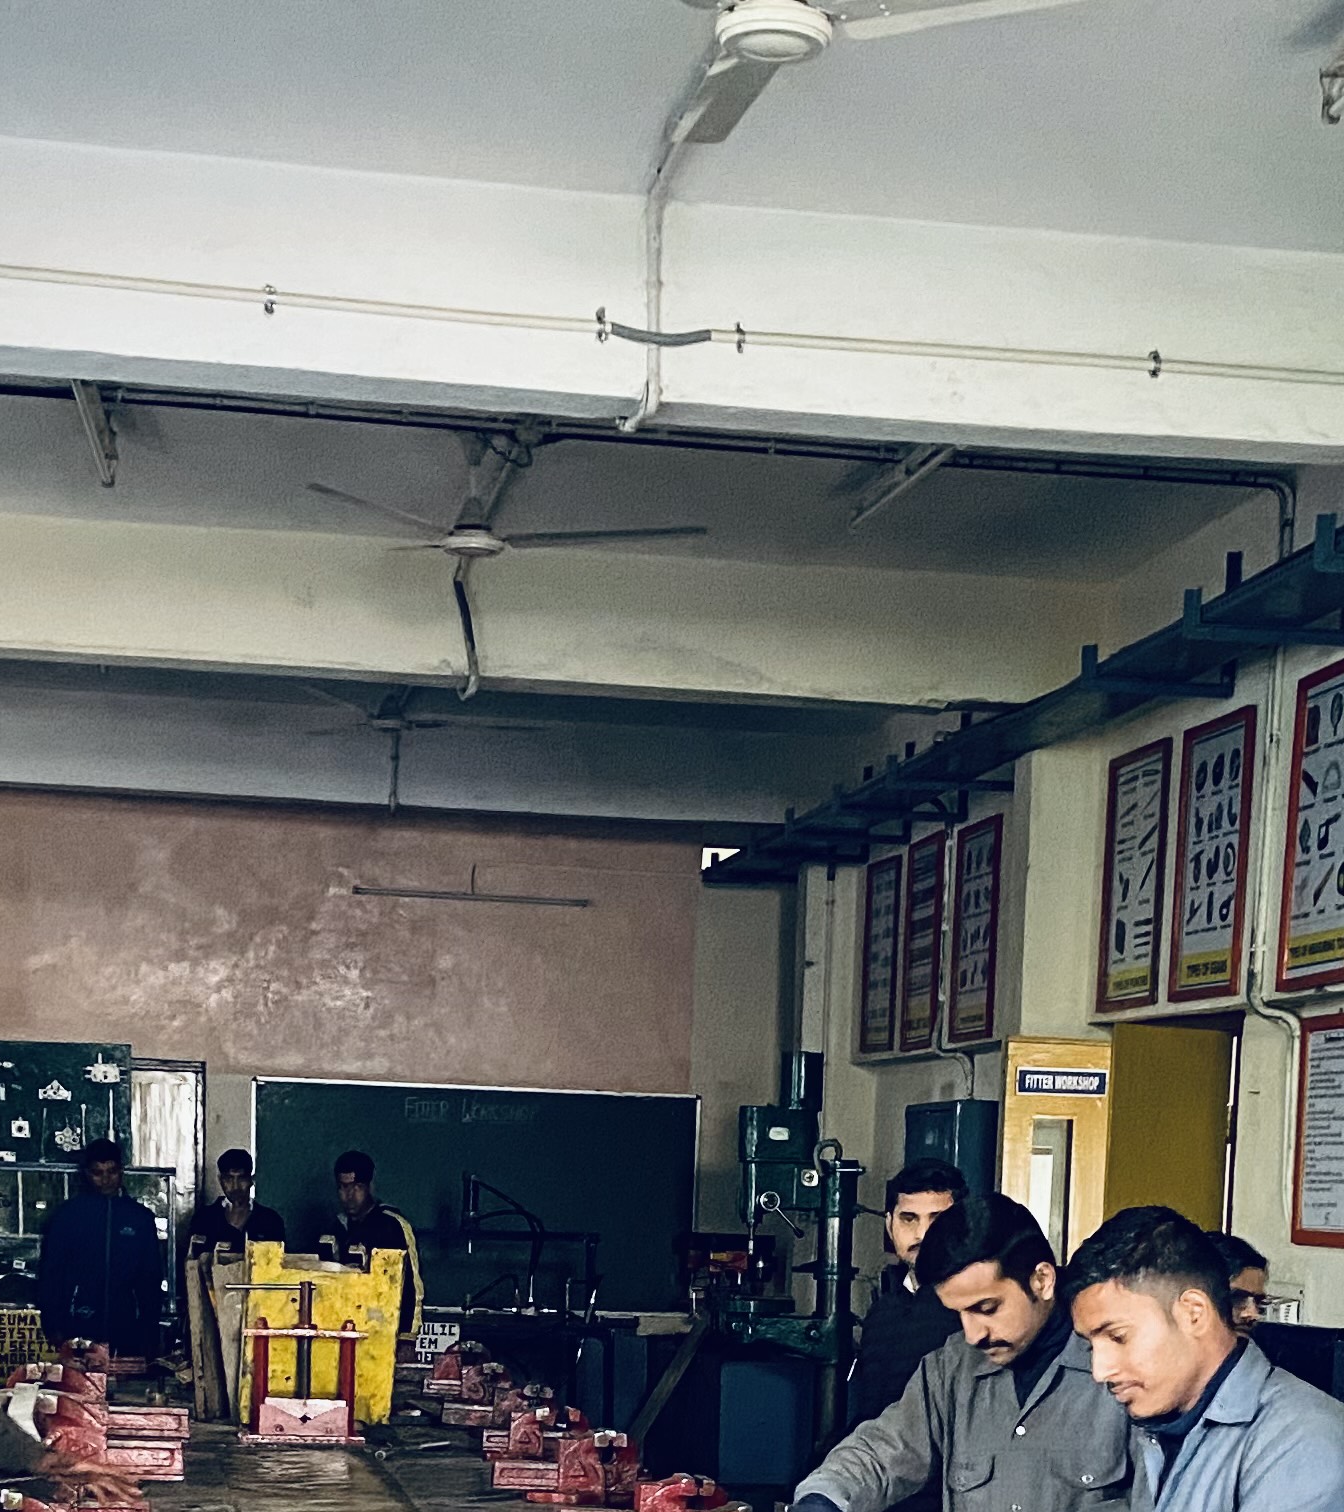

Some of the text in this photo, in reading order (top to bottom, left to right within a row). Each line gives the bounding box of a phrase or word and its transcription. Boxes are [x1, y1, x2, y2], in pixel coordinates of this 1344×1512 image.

[1025, 1074, 1100, 1091] FITTER WORKSHOP
[422, 1323, 456, 1335] ULIC
